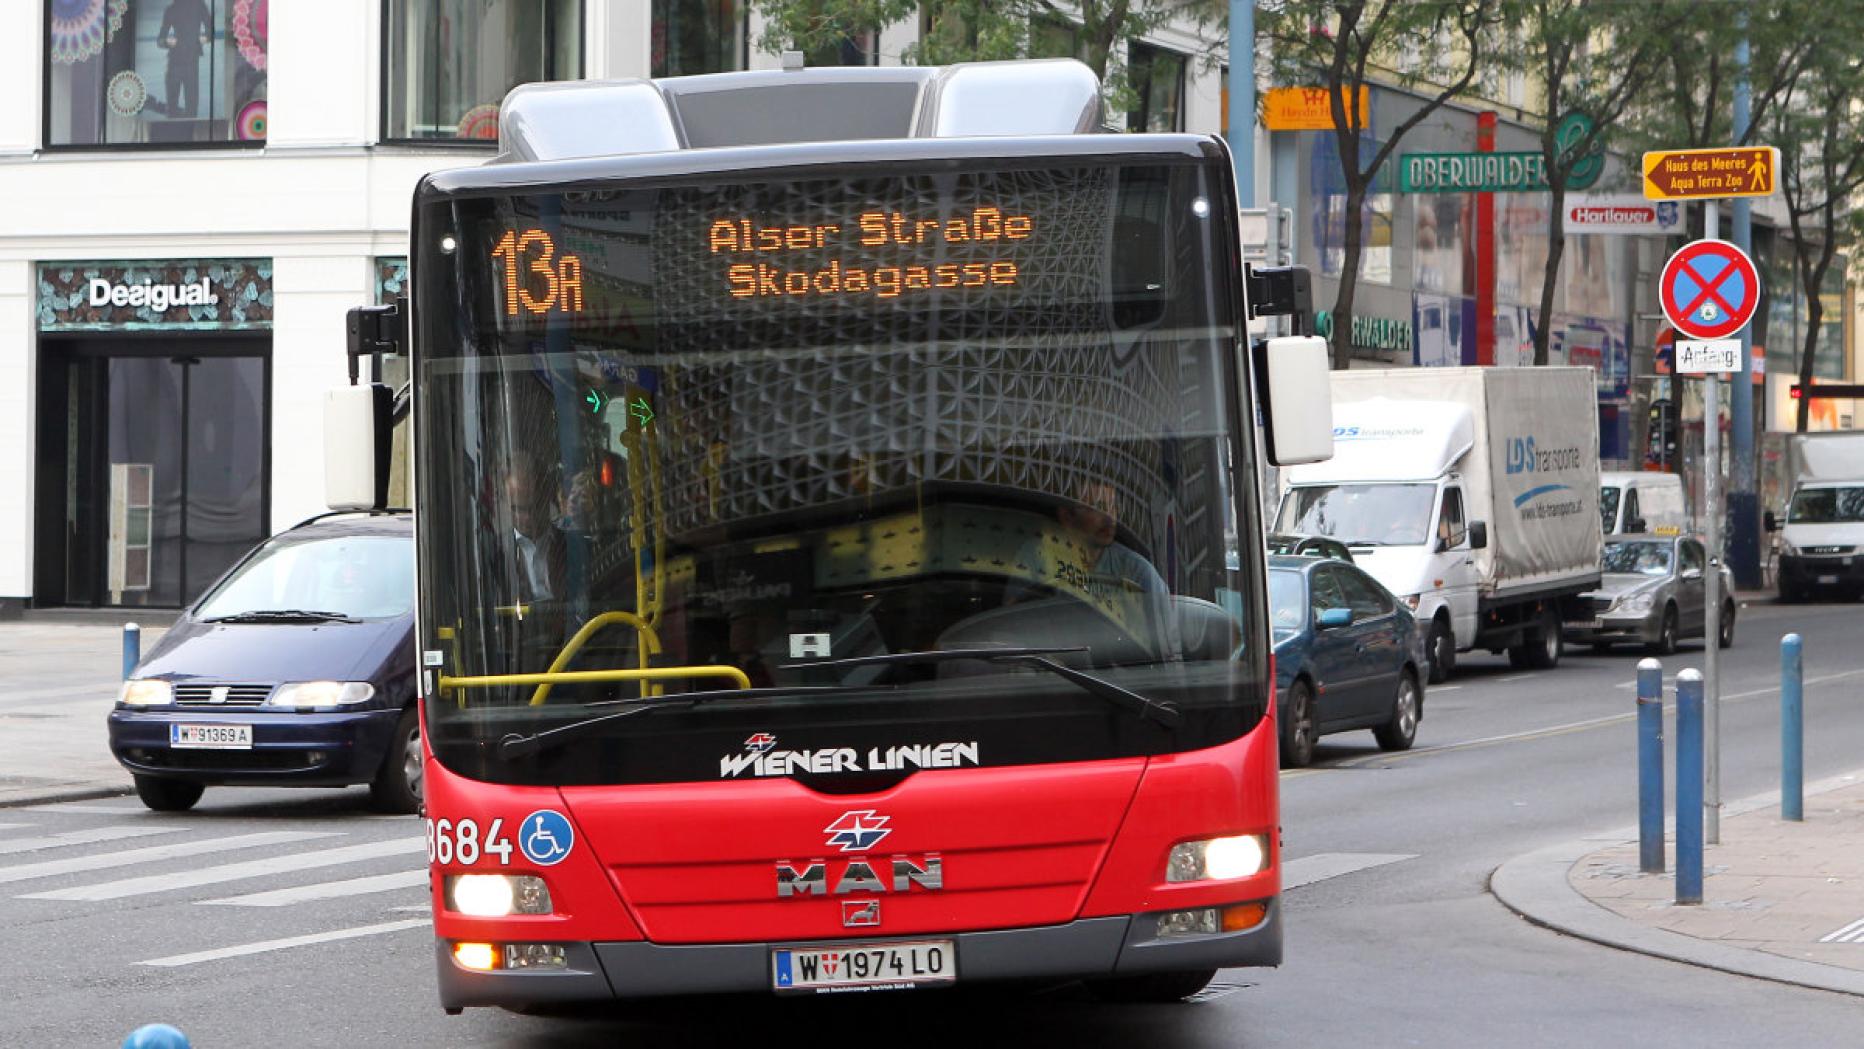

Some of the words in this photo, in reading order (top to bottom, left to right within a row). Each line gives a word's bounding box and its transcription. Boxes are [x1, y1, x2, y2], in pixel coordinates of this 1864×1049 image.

[1409, 155, 1550, 187] OBERWALDER
[1666, 159, 1688, 173] Haus
[1692, 158, 1708, 172] des
[1712, 157, 1746, 170] Meeres
[1671, 176, 1694, 191] Aqua
[1698, 175, 1722, 188] Terra
[1725, 173, 1743, 187] Zoo
[710, 219, 840, 253] Alser
[859, 207, 1033, 245] Straße
[1577, 207, 1649, 223] Hartlauer
[490, 228, 584, 316] 13A
[728, 260, 1018, 299] Skodagasse
[1324, 313, 1413, 351] ORWALDER
[1332, 426, 1360, 437] DS
[868, 741, 980, 771] LINIEN
[427, 818, 513, 865] 8684
[776, 853, 944, 897] MAN
